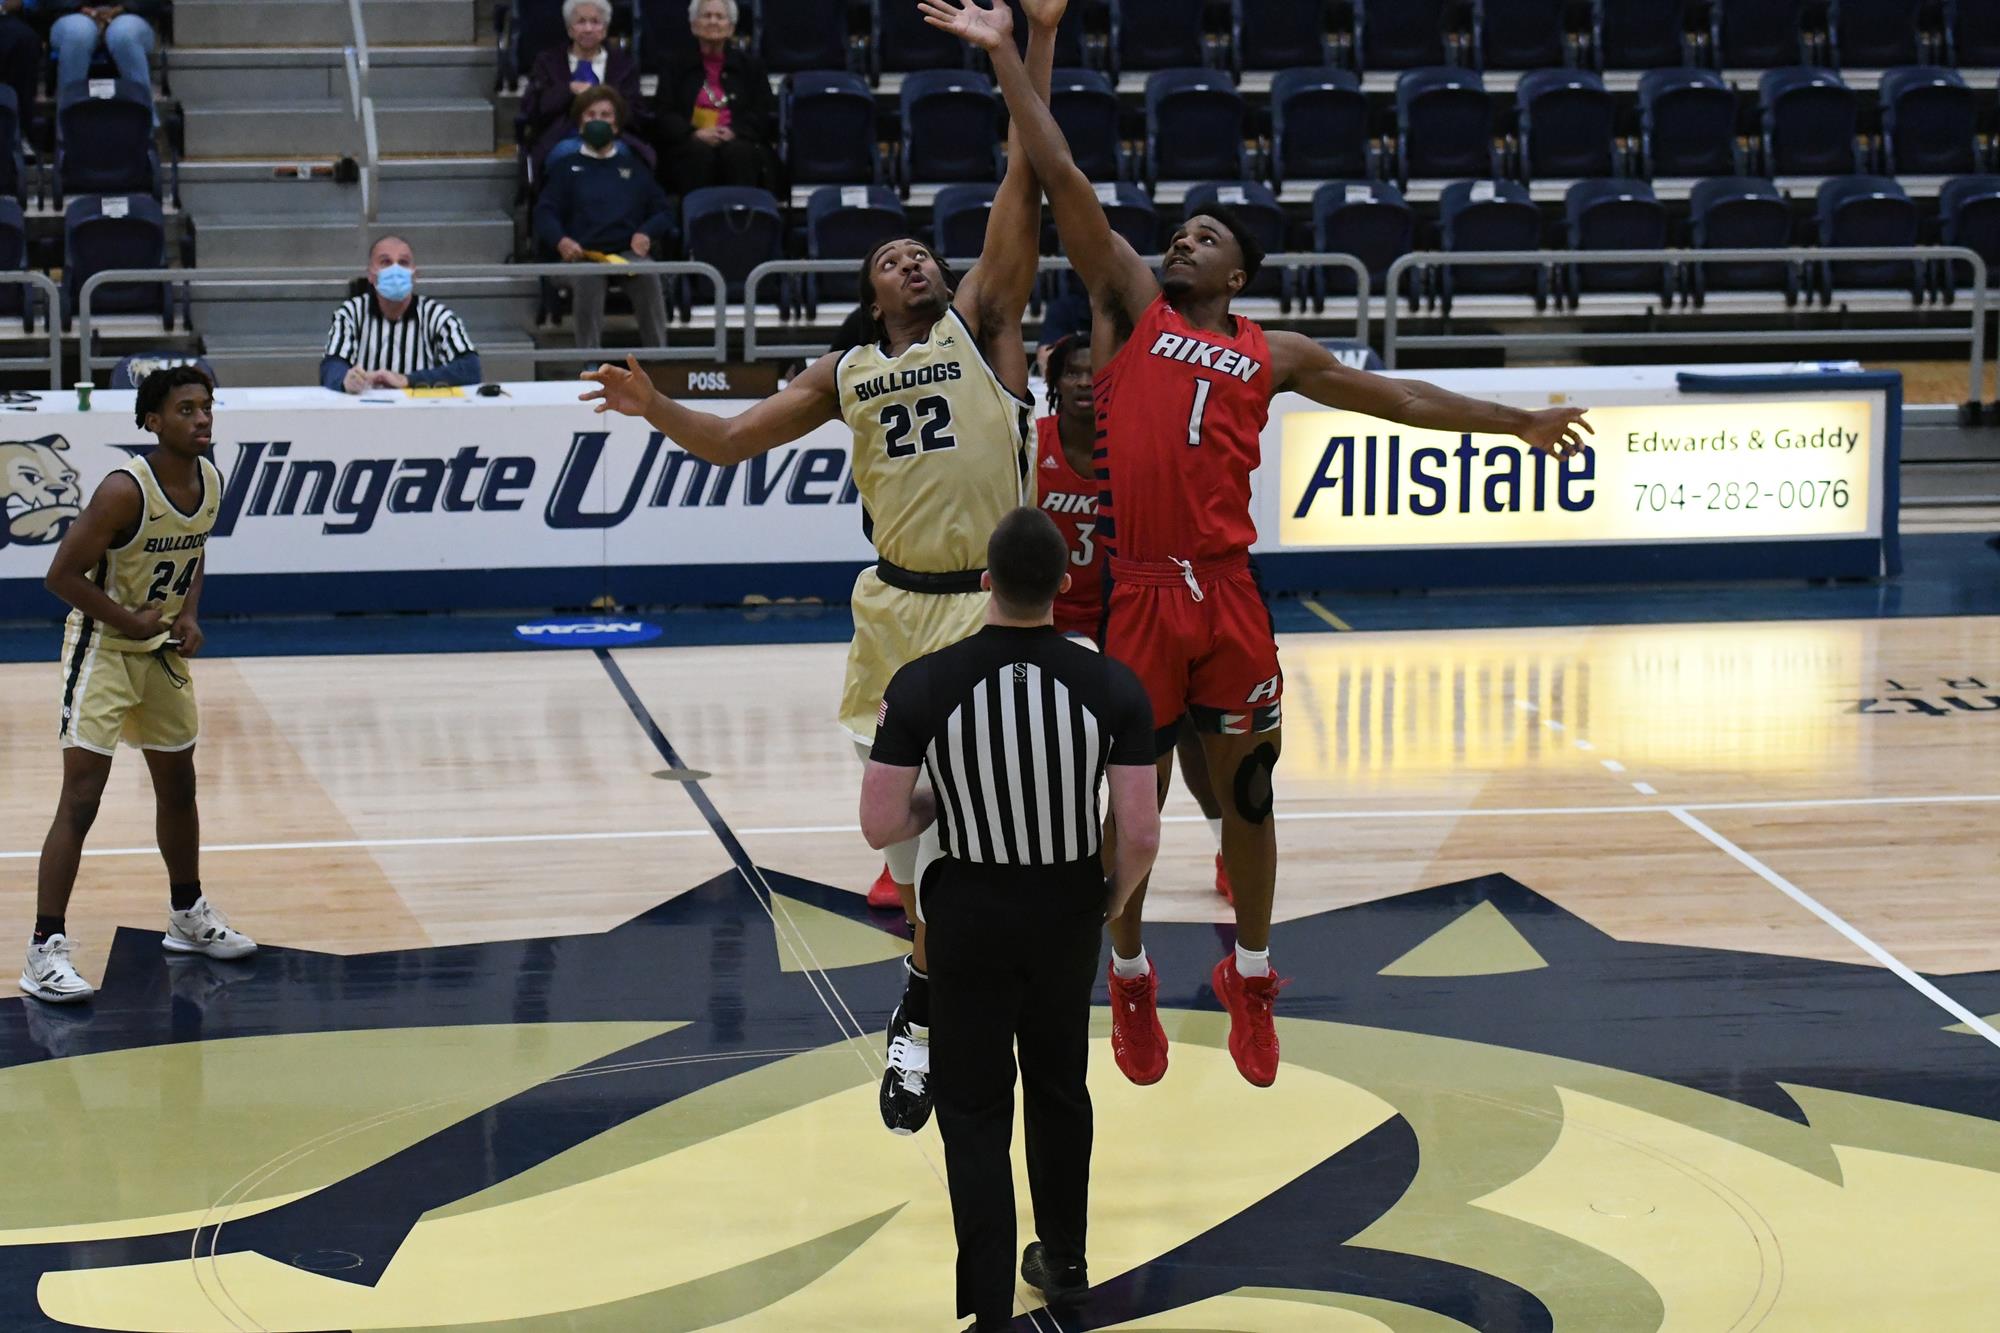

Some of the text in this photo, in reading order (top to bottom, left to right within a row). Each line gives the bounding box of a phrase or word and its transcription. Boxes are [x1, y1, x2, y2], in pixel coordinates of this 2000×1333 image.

[1150, 332, 1261, 383] AIKEN
[688, 372, 730, 391] POSS.
[854, 361, 961, 402] BULLDOGS
[879, 395, 957, 459] 22
[1187, 377, 1211, 446] 1
[1627, 426, 1859, 454] Edwards & Gaddy
[1293, 433, 1596, 518] Allstate
[1633, 479, 1850, 512] 704-282-0076
[1070, 522, 1096, 566] 3
[147, 557, 200, 602] 24
[516, 622, 642, 635] NCAA
[1245, 674, 1278, 703] A
